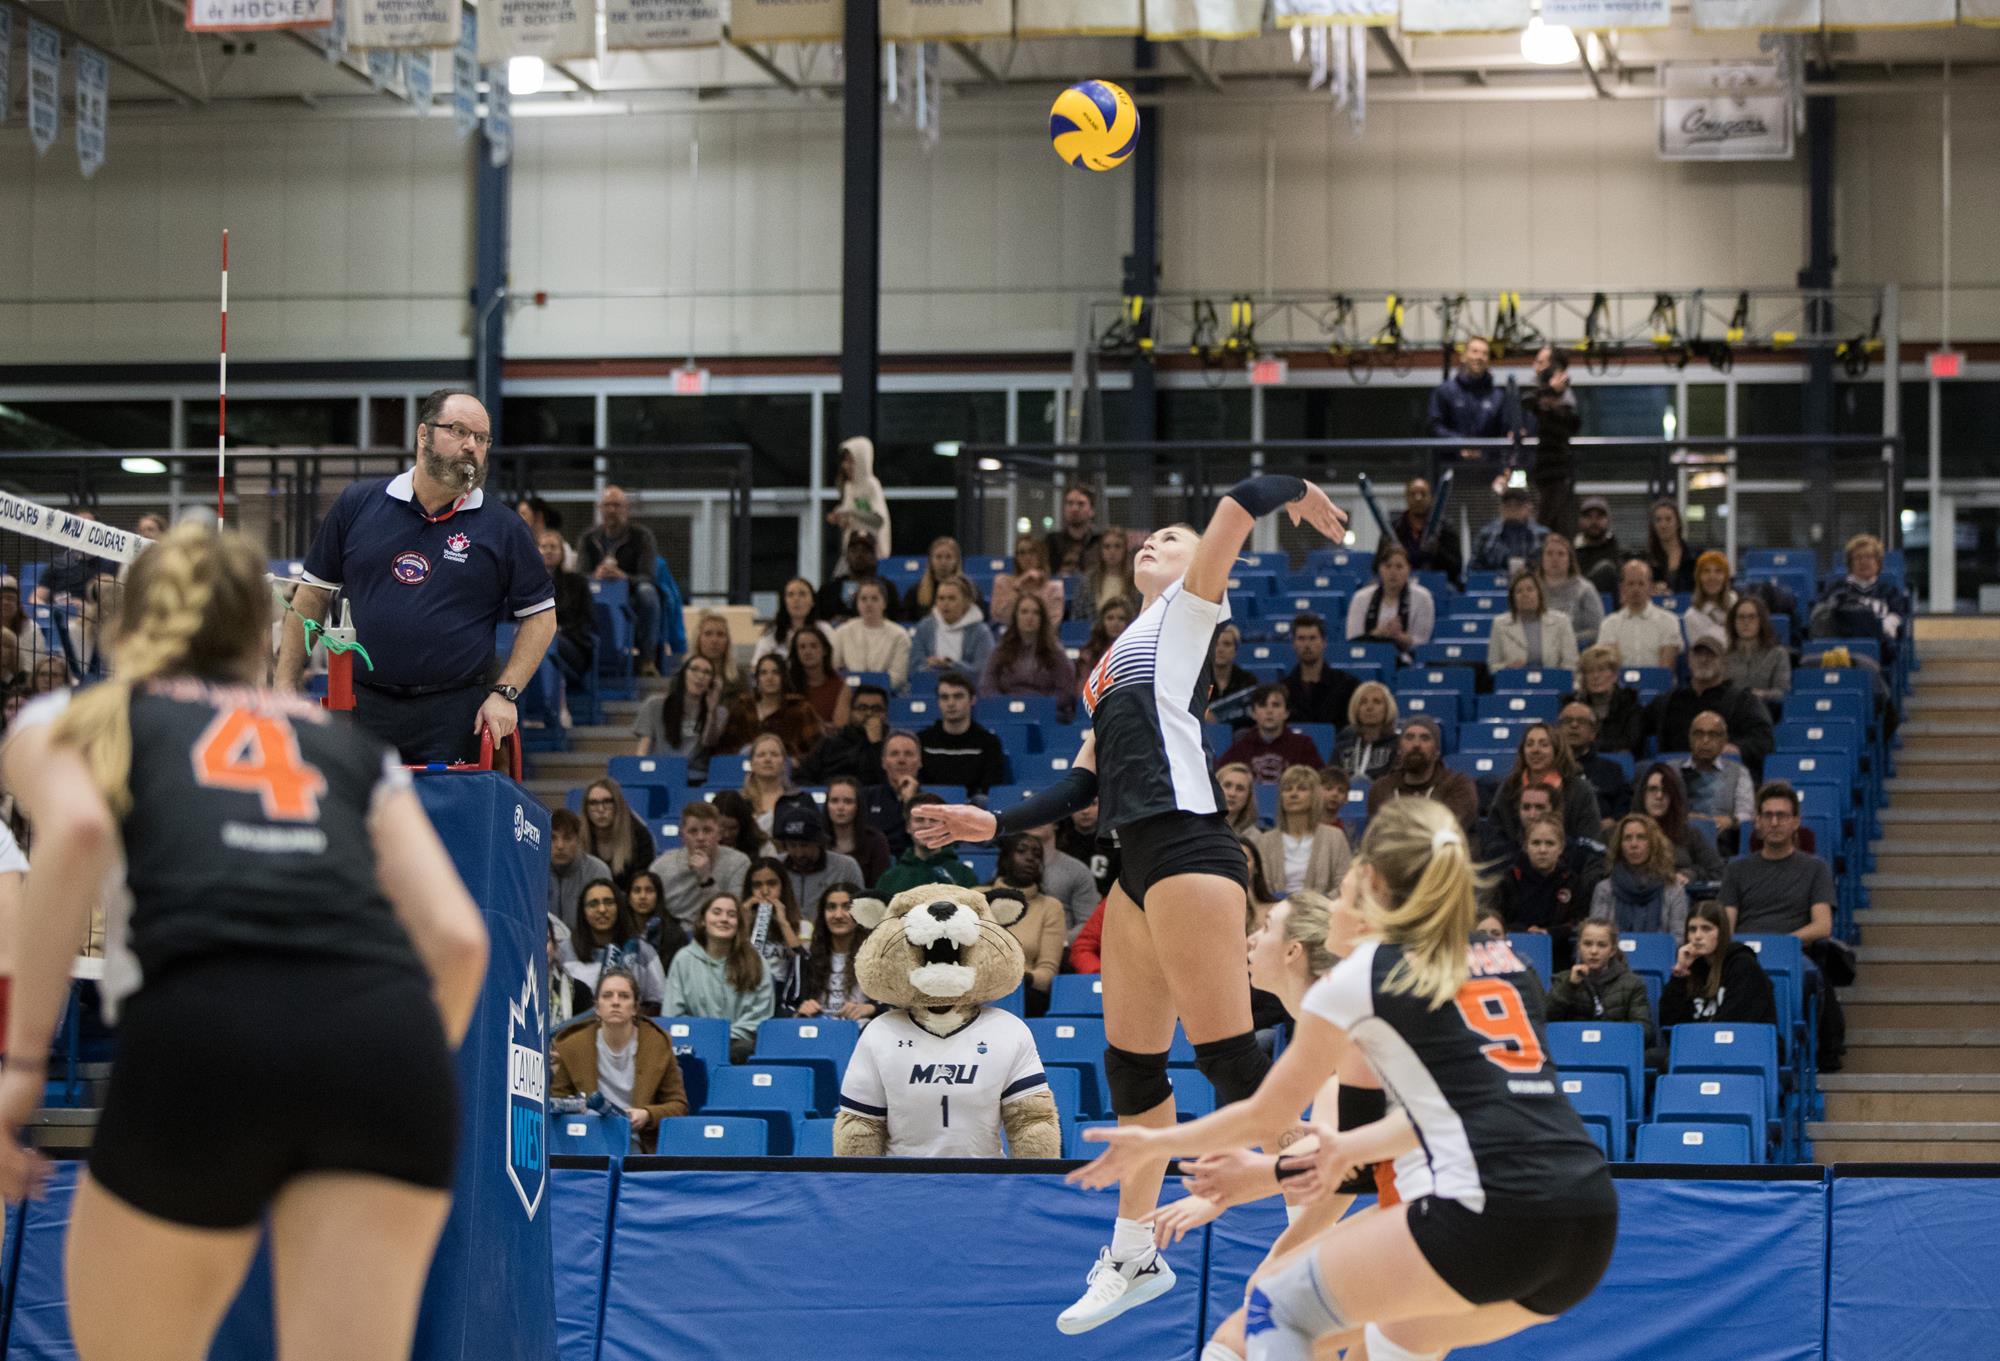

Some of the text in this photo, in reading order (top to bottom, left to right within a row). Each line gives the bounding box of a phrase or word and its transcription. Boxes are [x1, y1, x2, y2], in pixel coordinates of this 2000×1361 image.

[231, 0, 318, 19] HOCKEY
[87, 525, 127, 553] COUGARS
[190, 706, 329, 823] 4
[1454, 976, 1549, 1074] 9
[908, 1063, 979, 1085] MRU
[940, 1094, 949, 1128] 1
